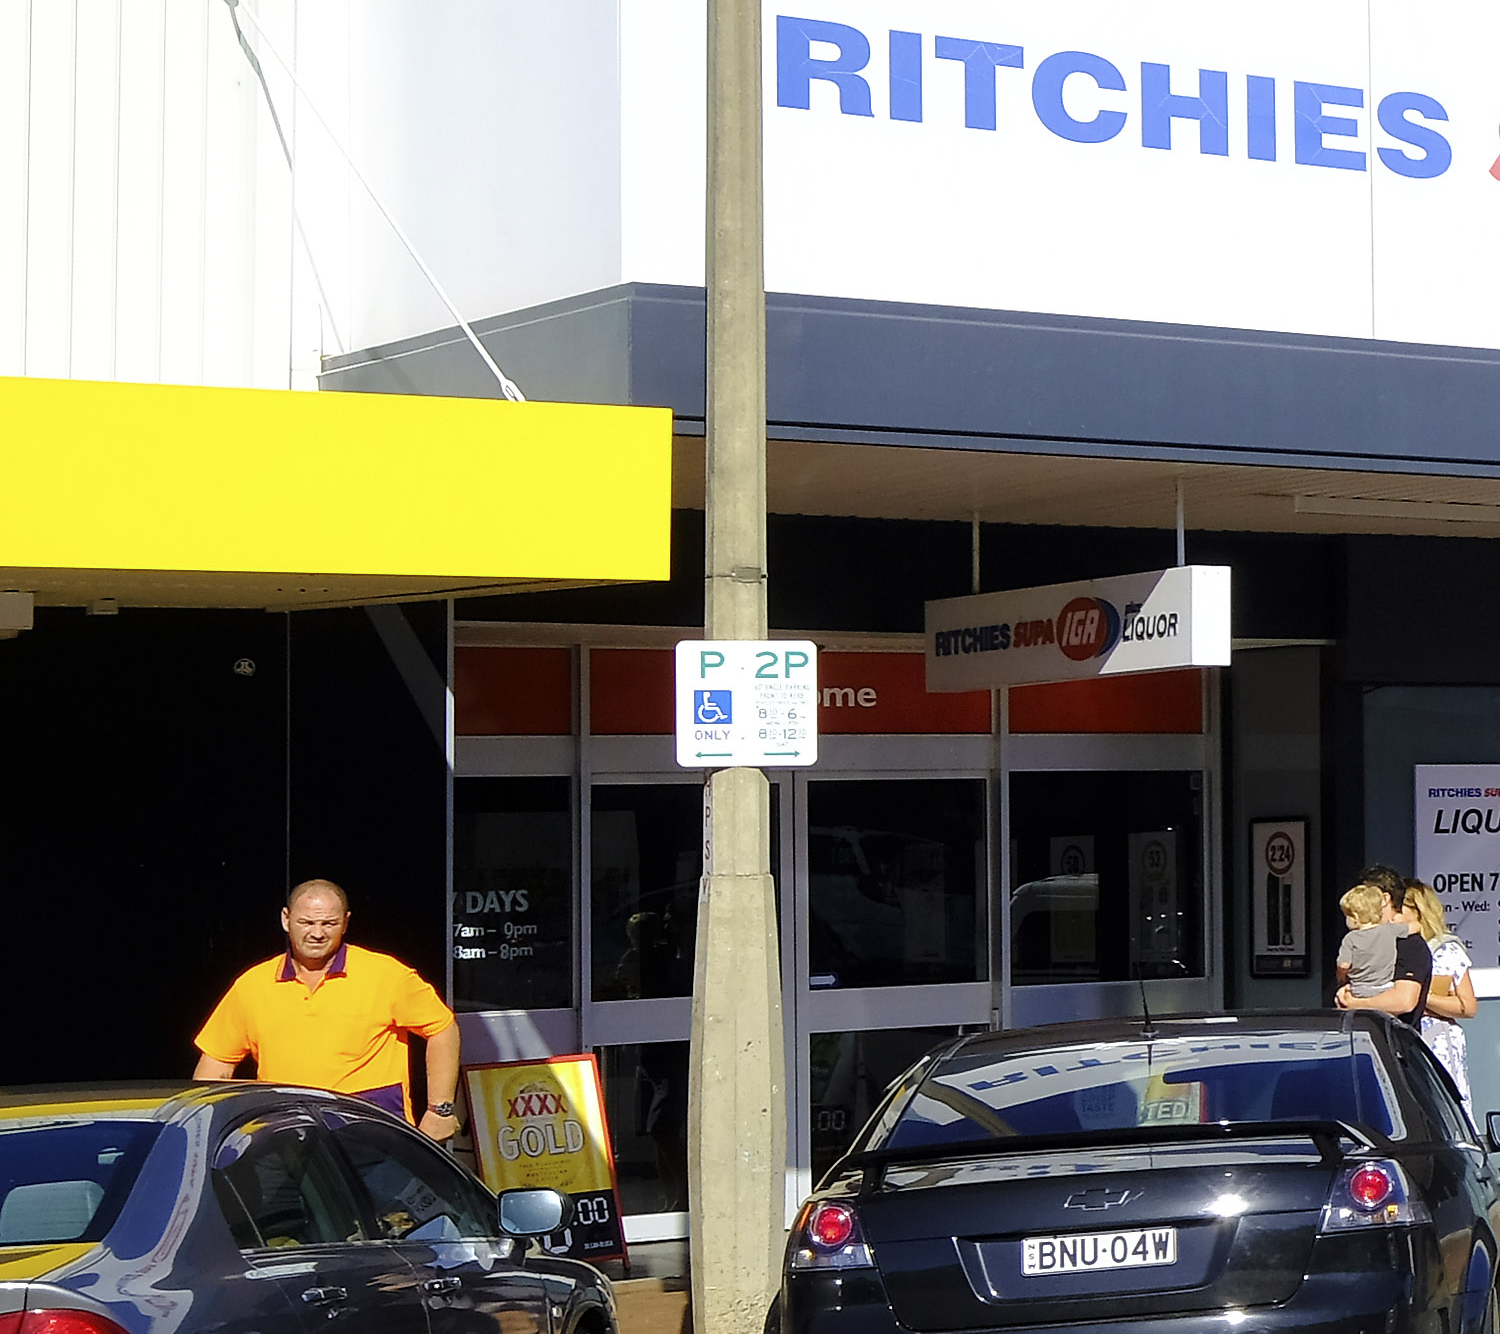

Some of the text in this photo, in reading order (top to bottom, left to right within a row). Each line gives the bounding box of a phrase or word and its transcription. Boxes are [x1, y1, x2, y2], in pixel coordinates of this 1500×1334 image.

[777, 15, 1452, 179] RITCHIES
[935, 609, 1099, 657] RITCHIES SUPA IGA
[1121, 611, 1179, 642] LIQUOR
[700, 651, 725, 679] P
[755, 651, 809, 679] 2P
[818, 686, 877, 707] me
[694, 729, 731, 741] ONLY
[1428, 787, 1481, 798] RITCHIES
[1433, 872, 1484, 893] OPEN
[1489, 872, 1500, 892] 7
[465, 889, 530, 914] DAYS
[1461, 900, 1490, 912] Wed:
[453, 921, 538, 939] 7am 9pm
[453, 943, 534, 961] 8am 8pm
[507, 1093, 568, 1119] XXXX
[498, 1120, 585, 1161] GOLD
